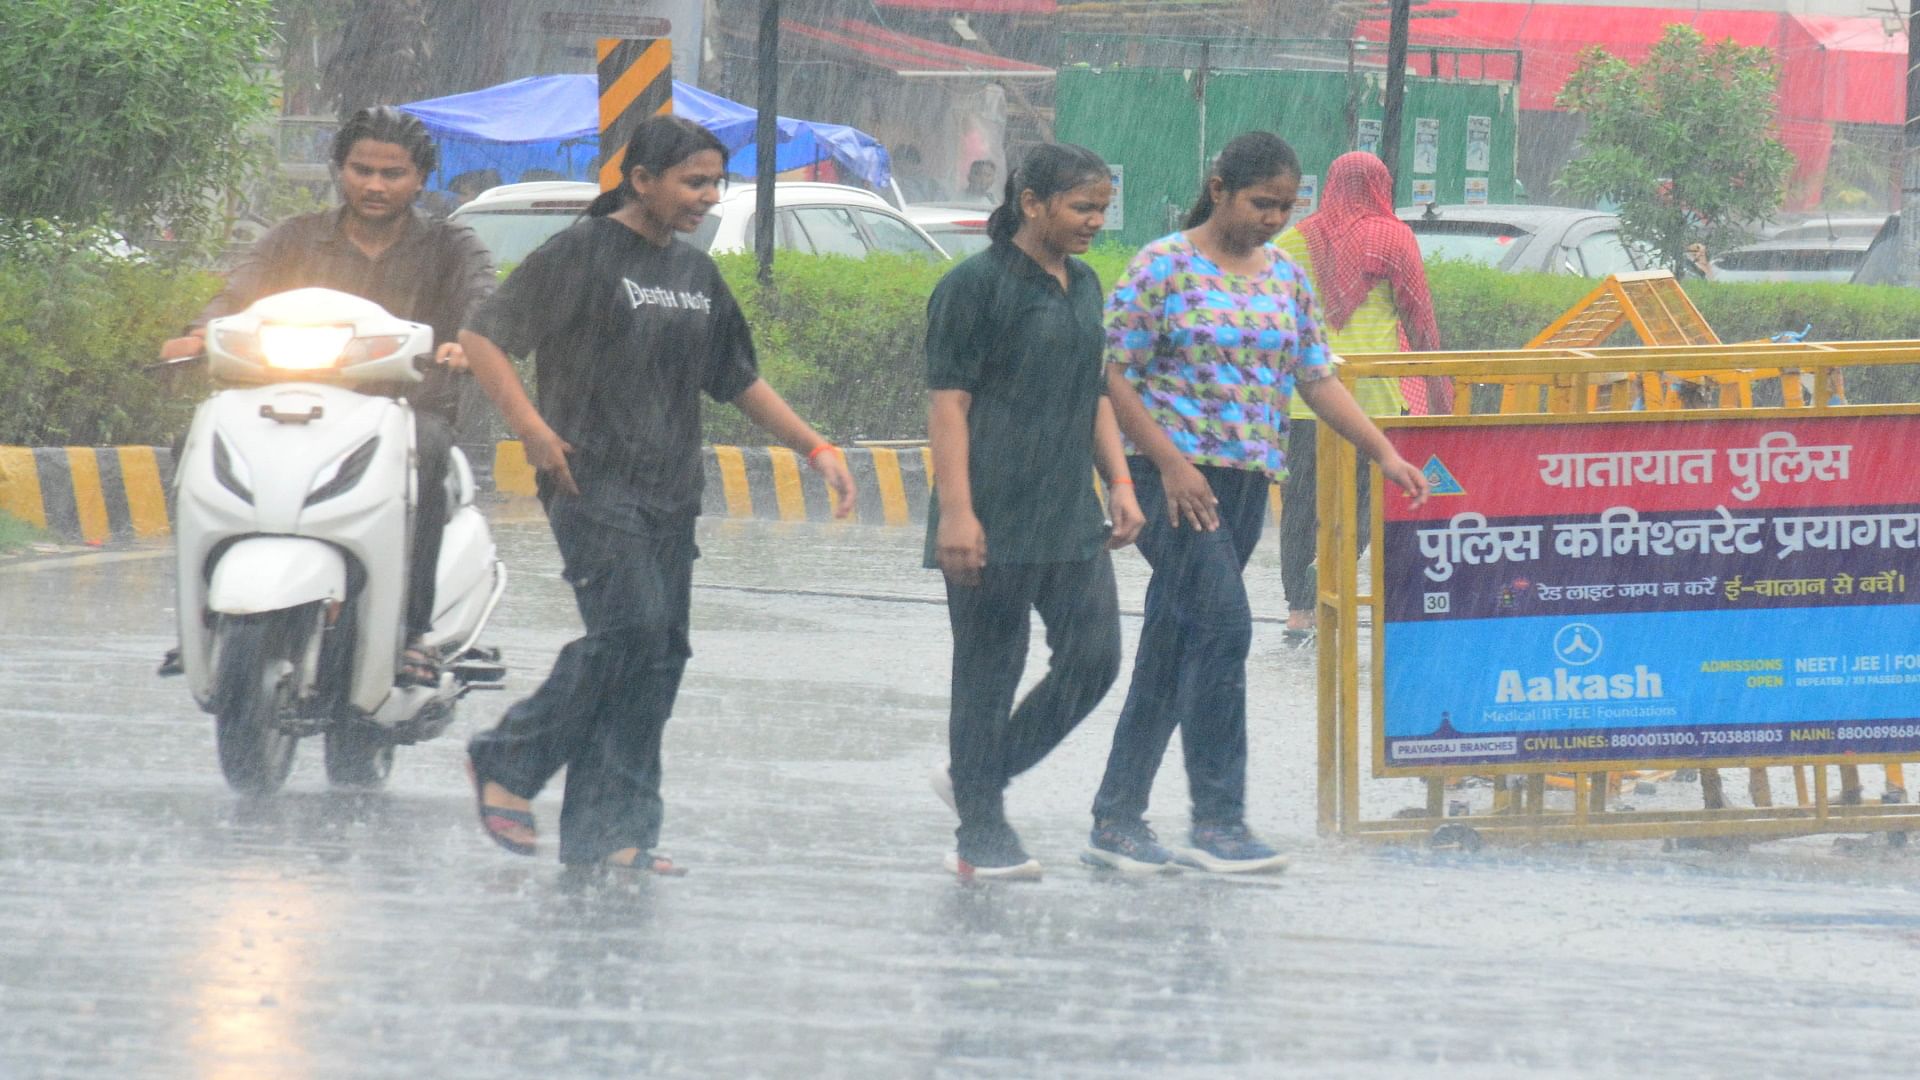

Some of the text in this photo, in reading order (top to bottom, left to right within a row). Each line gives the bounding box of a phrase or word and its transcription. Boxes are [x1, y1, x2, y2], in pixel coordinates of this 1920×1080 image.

[1539, 431, 1852, 501] यातायात पुलिस
[1417, 504, 1920, 582] पुलिस कमिश्नरेट प्रयागर
[1537, 584, 1562, 601] रेड
[1566, 584, 1615, 602] लाइट
[1618, 582, 1659, 598] जम्प
[1663, 582, 1680, 596] न
[1684, 576, 1718, 596] करें
[1832, 573, 1854, 595] से
[1426, 596, 1448, 610] 30
[1700, 658, 1783, 673] ADMISSIONS
[1795, 656, 1838, 672] NEET
[1851, 655, 1881, 671] JEE
[1494, 665, 1664, 704] Aakash
[1746, 675, 1784, 688] OPEN
[1795, 676, 1844, 687] REPEATER
[1483, 708, 1536, 722] Medical
[1597, 704, 1677, 719] Foundations
[1523, 738, 1562, 751] CIVIL
[1564, 735, 1609, 749] LINES:
[1611, 732, 1699, 748] 8800013100,
[1701, 730, 1783, 745] 7303881803
[1790, 728, 1835, 742] NAINI:
[1398, 741, 1514, 756] PRAYAGRAJ BRANCHES
